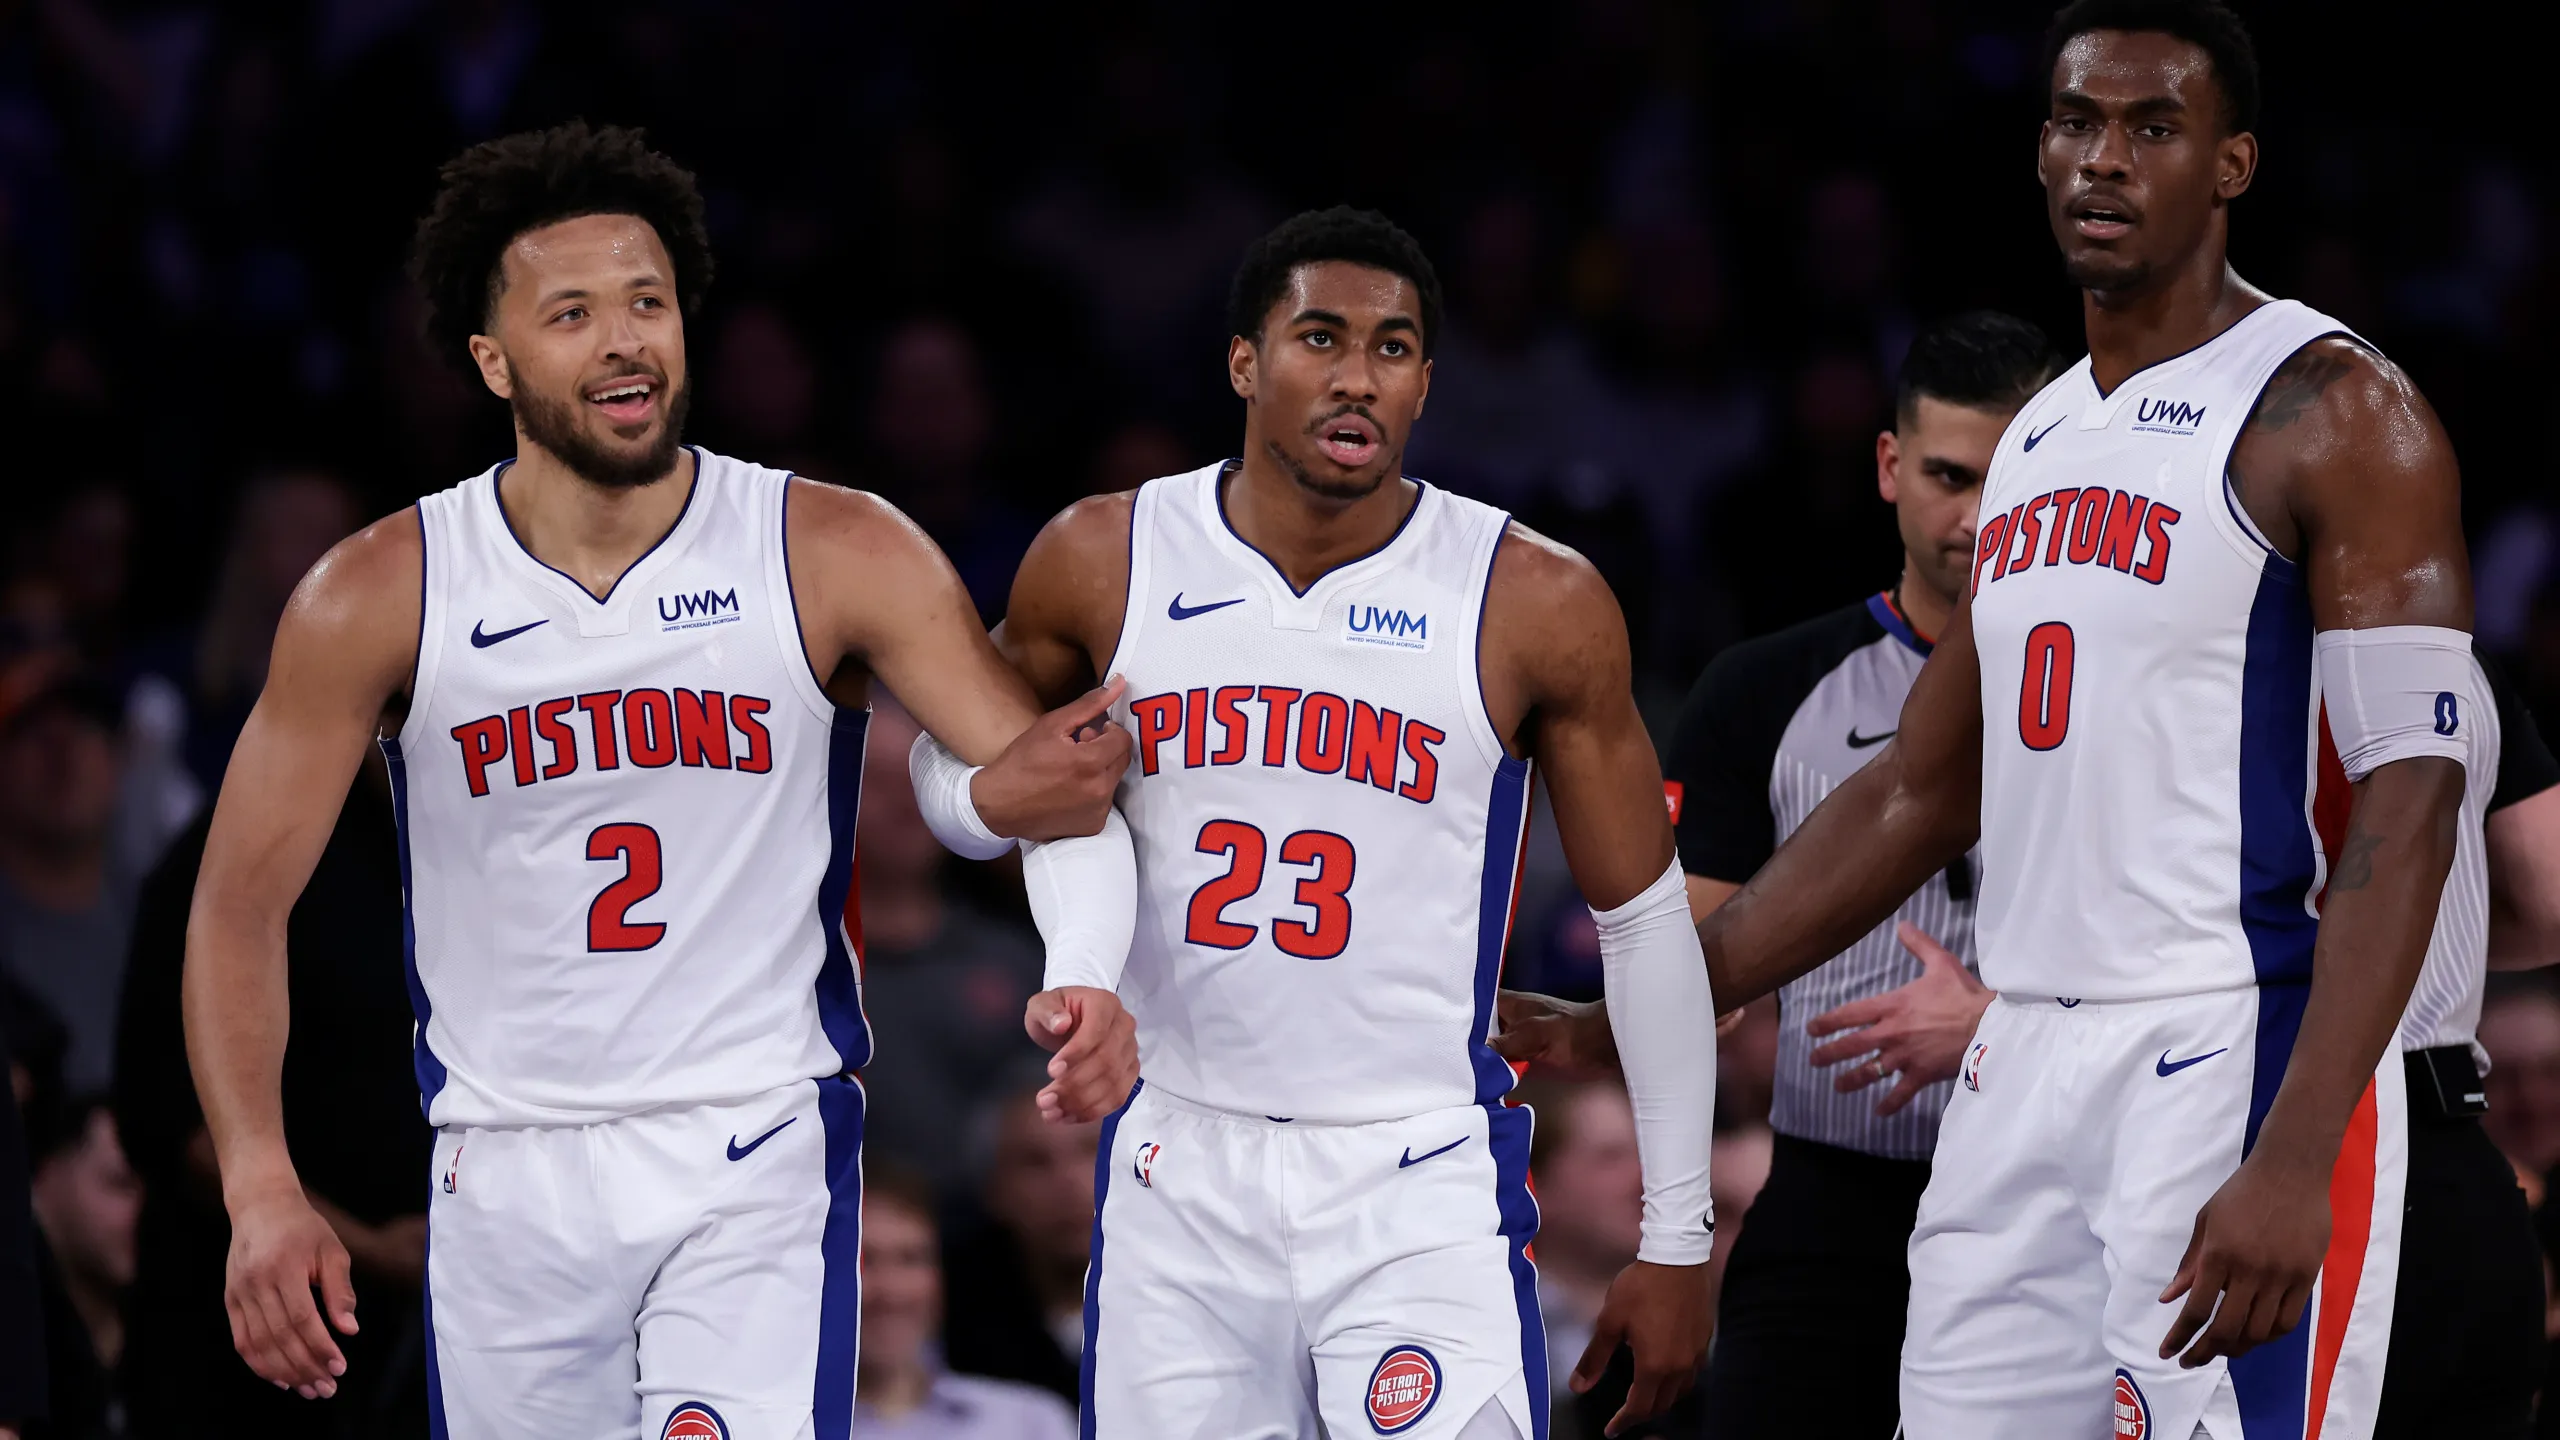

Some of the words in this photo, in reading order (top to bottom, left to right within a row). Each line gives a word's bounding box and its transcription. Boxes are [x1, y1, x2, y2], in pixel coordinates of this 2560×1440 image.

[2138, 398, 2207, 427] UWM
[1971, 486, 2181, 601] PISTONS
[658, 587, 739, 621] UWM
[681, 621, 711, 629] WHOLESALE
[712, 616, 740, 625] MORTGAGE
[1349, 605, 1426, 639] UWM
[1366, 638, 1395, 646] WHOLESALE
[1396, 641, 1425, 650] MORTGAGE
[2018, 621, 2075, 752] 0
[2434, 691, 2459, 736] 0
[451, 688, 773, 797] PISTONS
[1130, 685, 1446, 805] PISTONS
[586, 822, 667, 953] 2
[1184, 819, 1357, 960] 23
[1376, 1387, 1422, 1408] PISTONS
[1378, 1373, 1424, 1393] DETROIT
[2115, 1400, 2136, 1420] ETROIT
[2115, 1417, 2137, 1436] STONS
